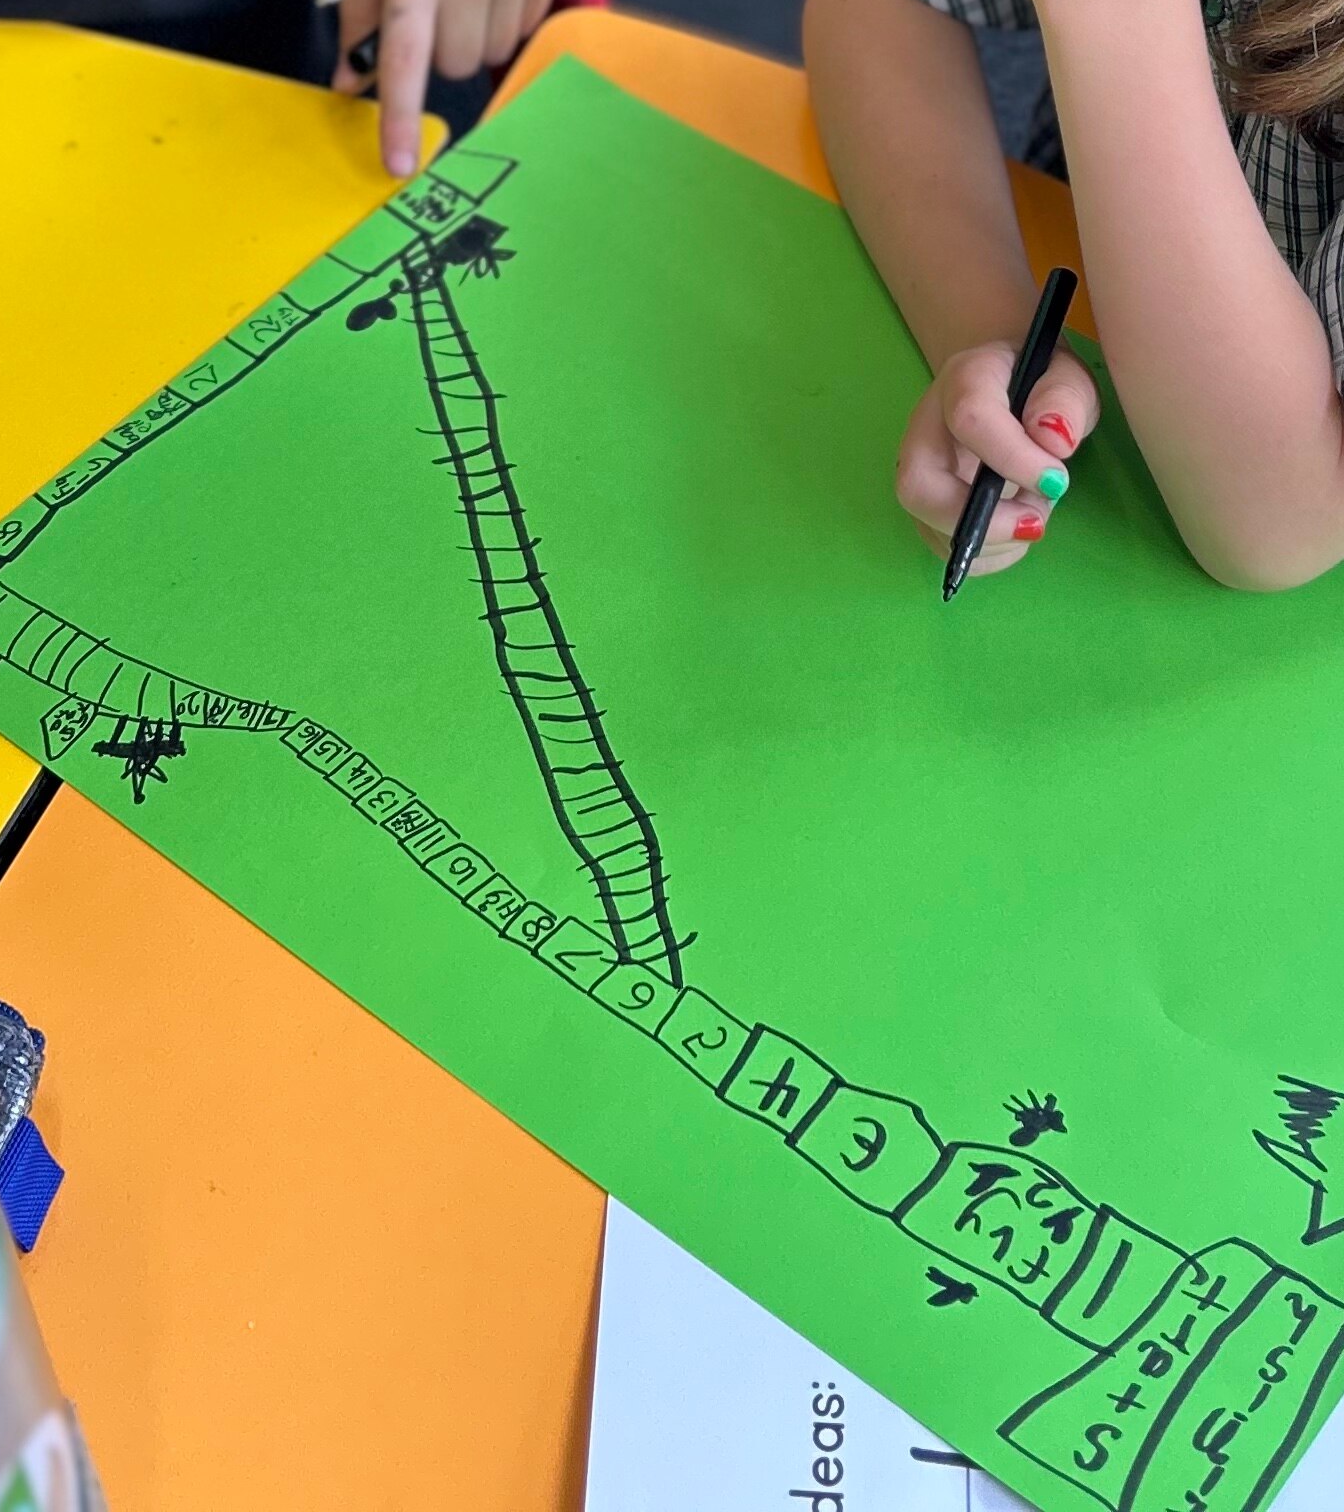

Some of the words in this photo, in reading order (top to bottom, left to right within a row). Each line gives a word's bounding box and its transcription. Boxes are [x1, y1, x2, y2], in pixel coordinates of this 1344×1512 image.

[249, 315, 281, 343] 22
[184, 363, 218, 390] 21
[313, 740, 344, 764] 15
[347, 761, 375, 790] 14
[367, 790, 400, 813] 13
[449, 857, 478, 885] 10
[521, 915, 556, 941] 8
[749, 1057, 800, 1118] 4
